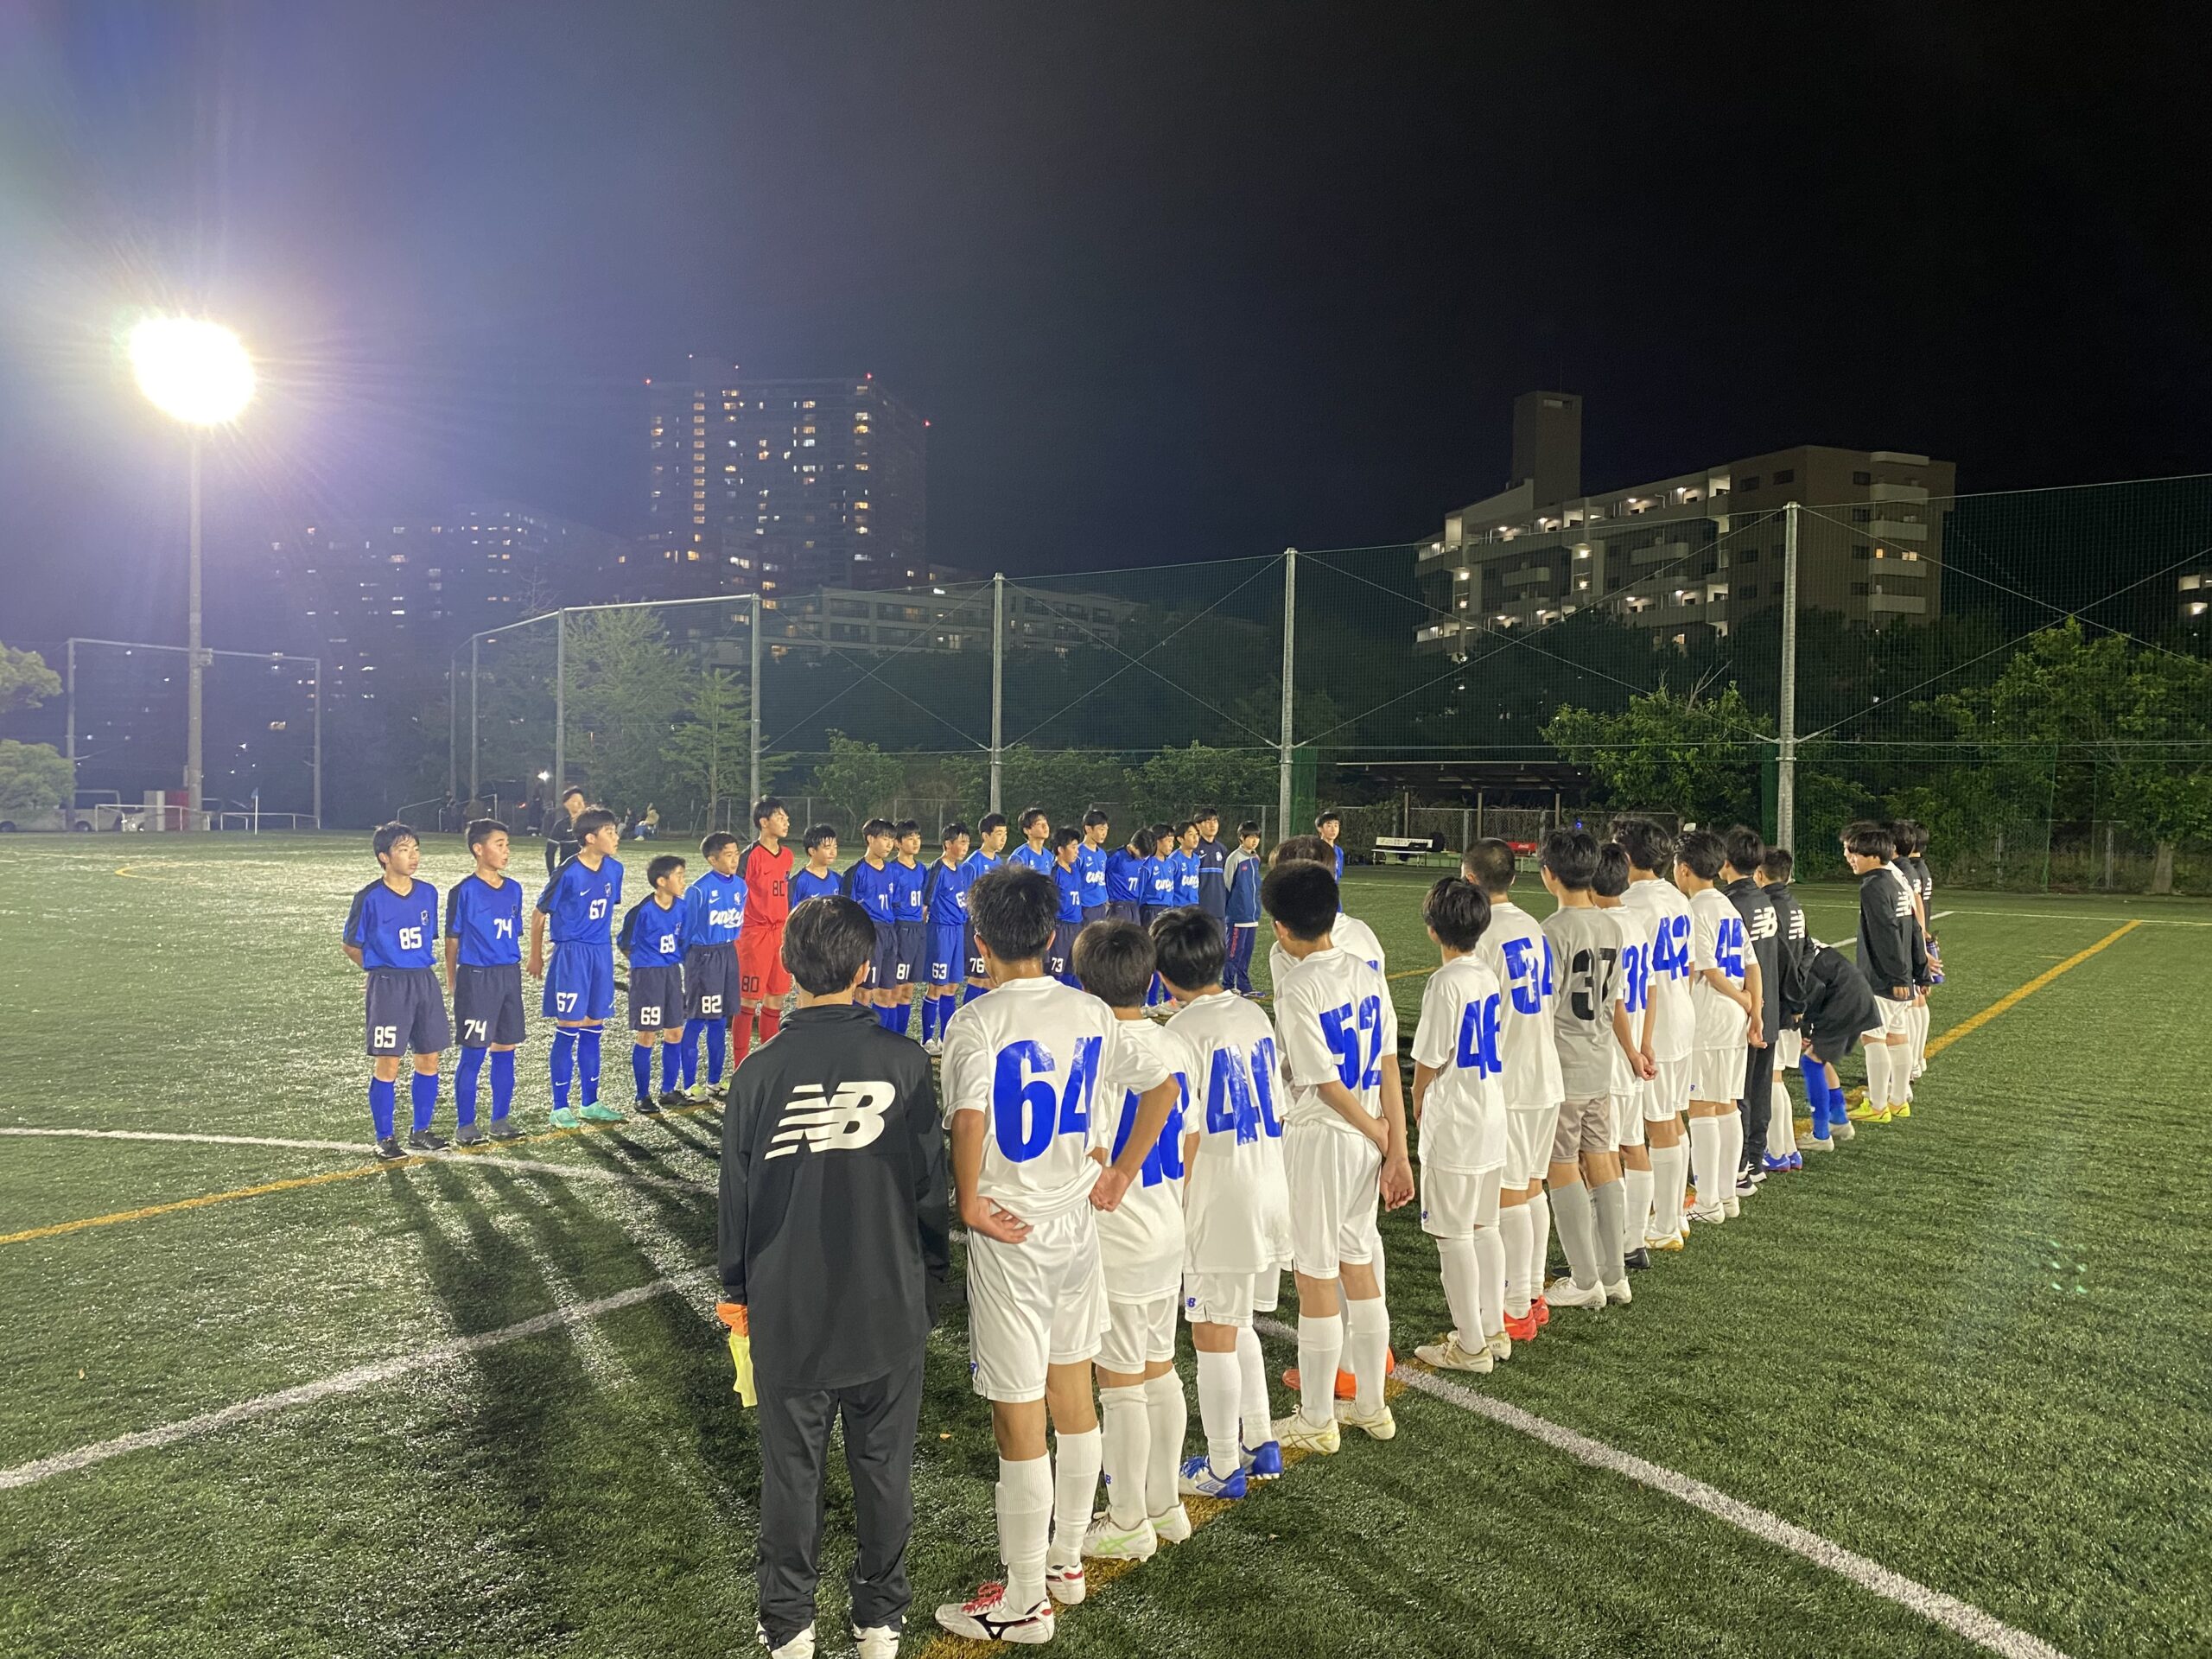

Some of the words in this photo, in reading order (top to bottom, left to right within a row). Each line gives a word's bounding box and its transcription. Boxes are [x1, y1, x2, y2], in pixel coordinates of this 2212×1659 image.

[1128, 877, 1138, 892] 77
[878, 893, 889, 911] 71
[910, 890, 921, 907] 81
[589, 899, 607, 920] 67
[398, 926, 422, 950] 85
[493, 918, 512, 939] 74
[659, 933, 676, 954] 69
[1651, 914, 1691, 981] 42
[1714, 918, 1745, 978] 45
[896, 963, 910, 981] 81
[931, 962, 948, 980] 63
[969, 957, 985, 974] 76
[1051, 957, 1065, 973] 73
[1501, 935, 1554, 1014] 54
[741, 975, 760, 993] 80
[1571, 947, 1618, 1021] 37
[556, 992, 579, 1014] 67
[701, 995, 722, 1014] 82
[640, 1007, 661, 1026] 69
[373, 1025, 397, 1049] 85
[463, 1019, 487, 1041] 74
[1319, 995, 1382, 1092] 52
[993, 1035, 1103, 1163] 64
[764, 1080, 896, 1161] NB
